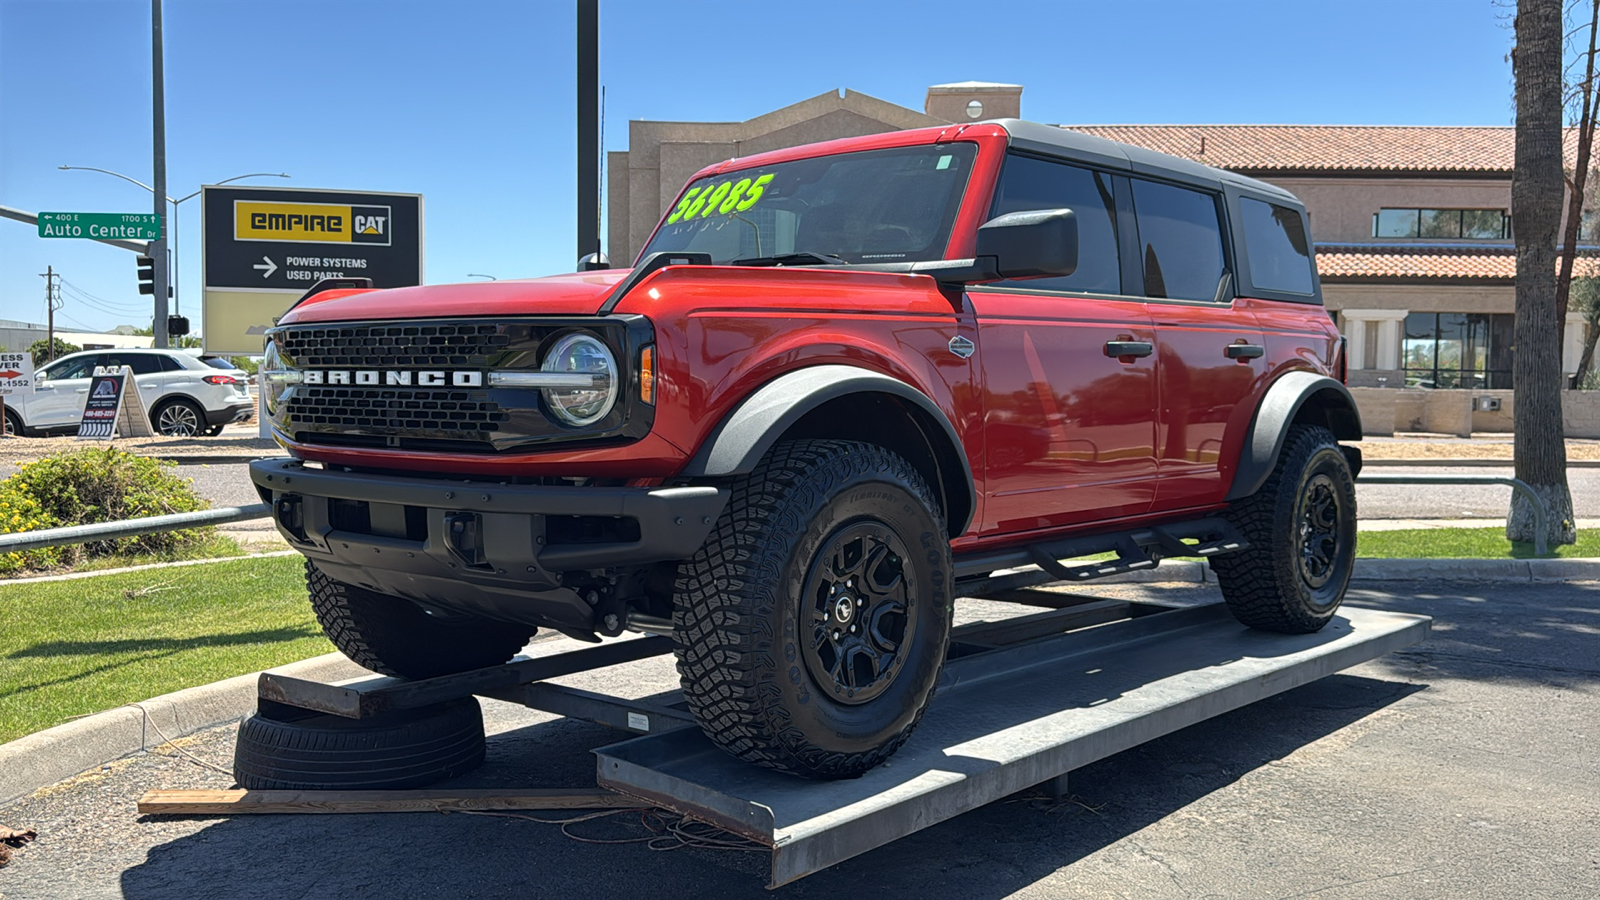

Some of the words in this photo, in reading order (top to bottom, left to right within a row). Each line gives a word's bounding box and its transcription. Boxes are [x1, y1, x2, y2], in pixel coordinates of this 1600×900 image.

[667, 173, 775, 225] 56985
[74, 214, 79, 222] E
[251, 213, 342, 233] EMPIRE
[354, 215, 385, 235] CAT
[44, 223, 82, 236] Auto
[89, 224, 143, 237] Center
[286, 256, 321, 267] POWER
[322, 258, 367, 269] SYSTEMS
[286, 270, 311, 280] USED
[313, 271, 344, 281] PARTS
[303, 370, 482, 387] BRONCO
